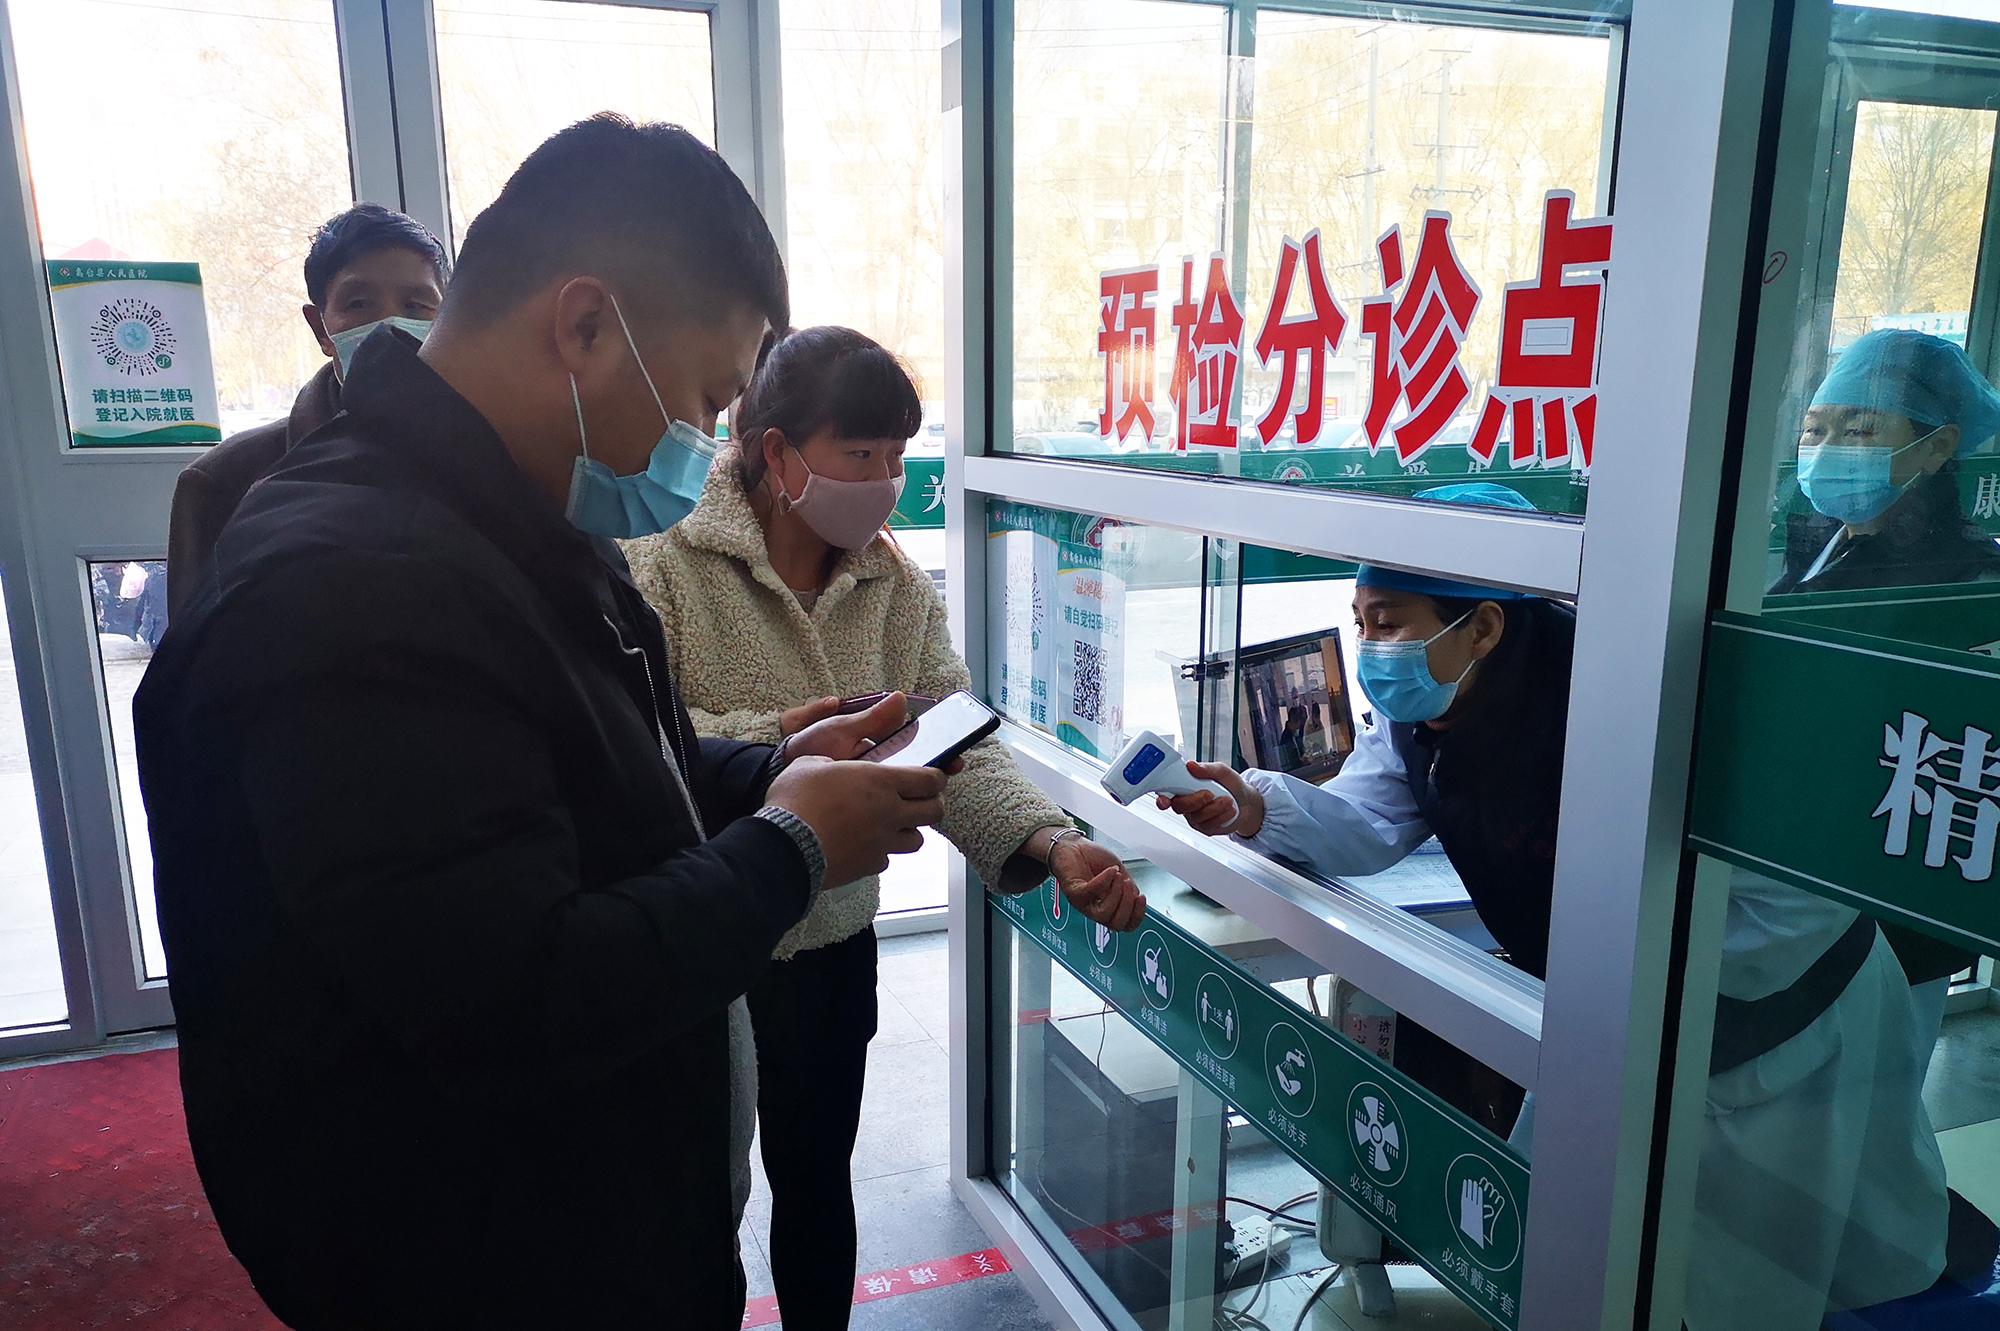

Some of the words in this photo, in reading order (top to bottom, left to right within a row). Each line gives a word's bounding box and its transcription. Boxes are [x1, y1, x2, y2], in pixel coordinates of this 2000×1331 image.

[1099, 189, 1613, 468] 预检分诊点
[91, 388, 194, 404] 请扫描二维码
[95, 407, 195, 422] 登记入院就医
[1063, 605, 1119, 638] 请自觉扫码登记
[1871, 711, 2000, 883] 精
[1089, 964, 1113, 992] 必须消毒
[1141, 1005, 1168, 1037] 必须清洁
[1267, 1108, 1307, 1148] 必须洗手
[1350, 1173, 1397, 1223] 必须通风
[1442, 1248, 1515, 1318] 必须戴手套
